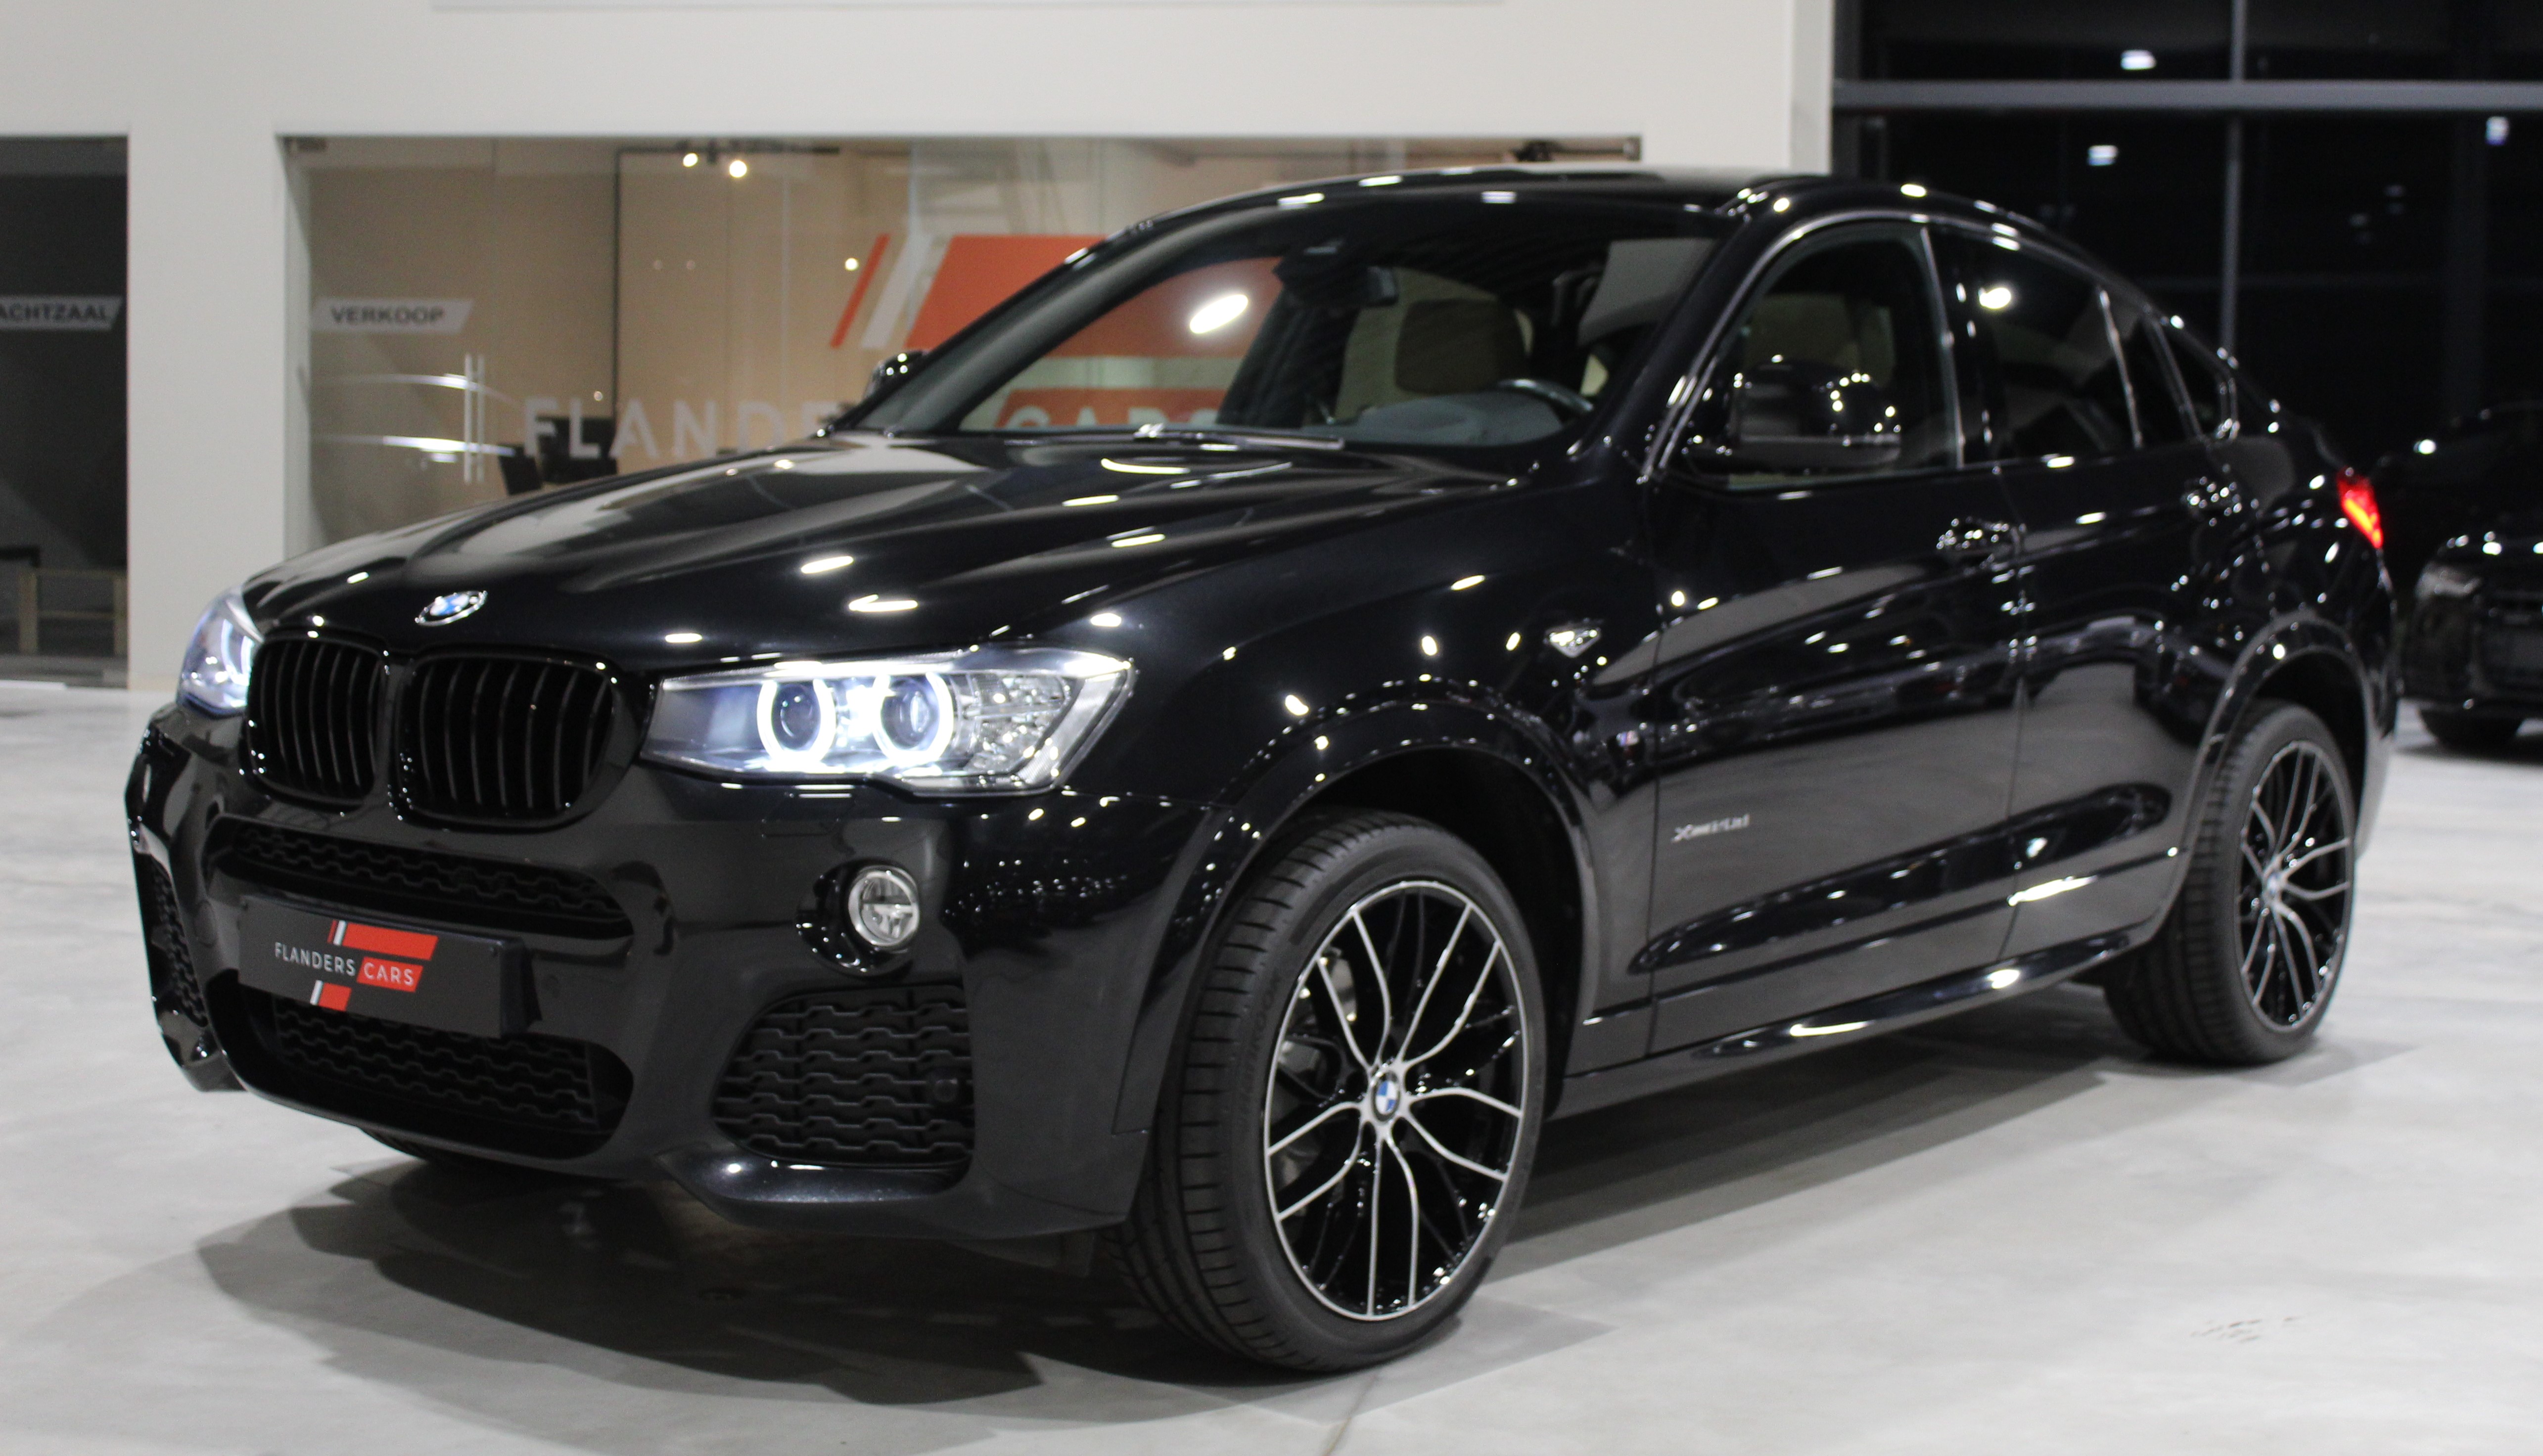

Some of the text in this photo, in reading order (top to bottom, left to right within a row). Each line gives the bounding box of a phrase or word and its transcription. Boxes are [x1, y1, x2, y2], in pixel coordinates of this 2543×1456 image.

[329, 305, 444, 323] VERKOOP
[275, 941, 415, 987] FLANDERS CARS
